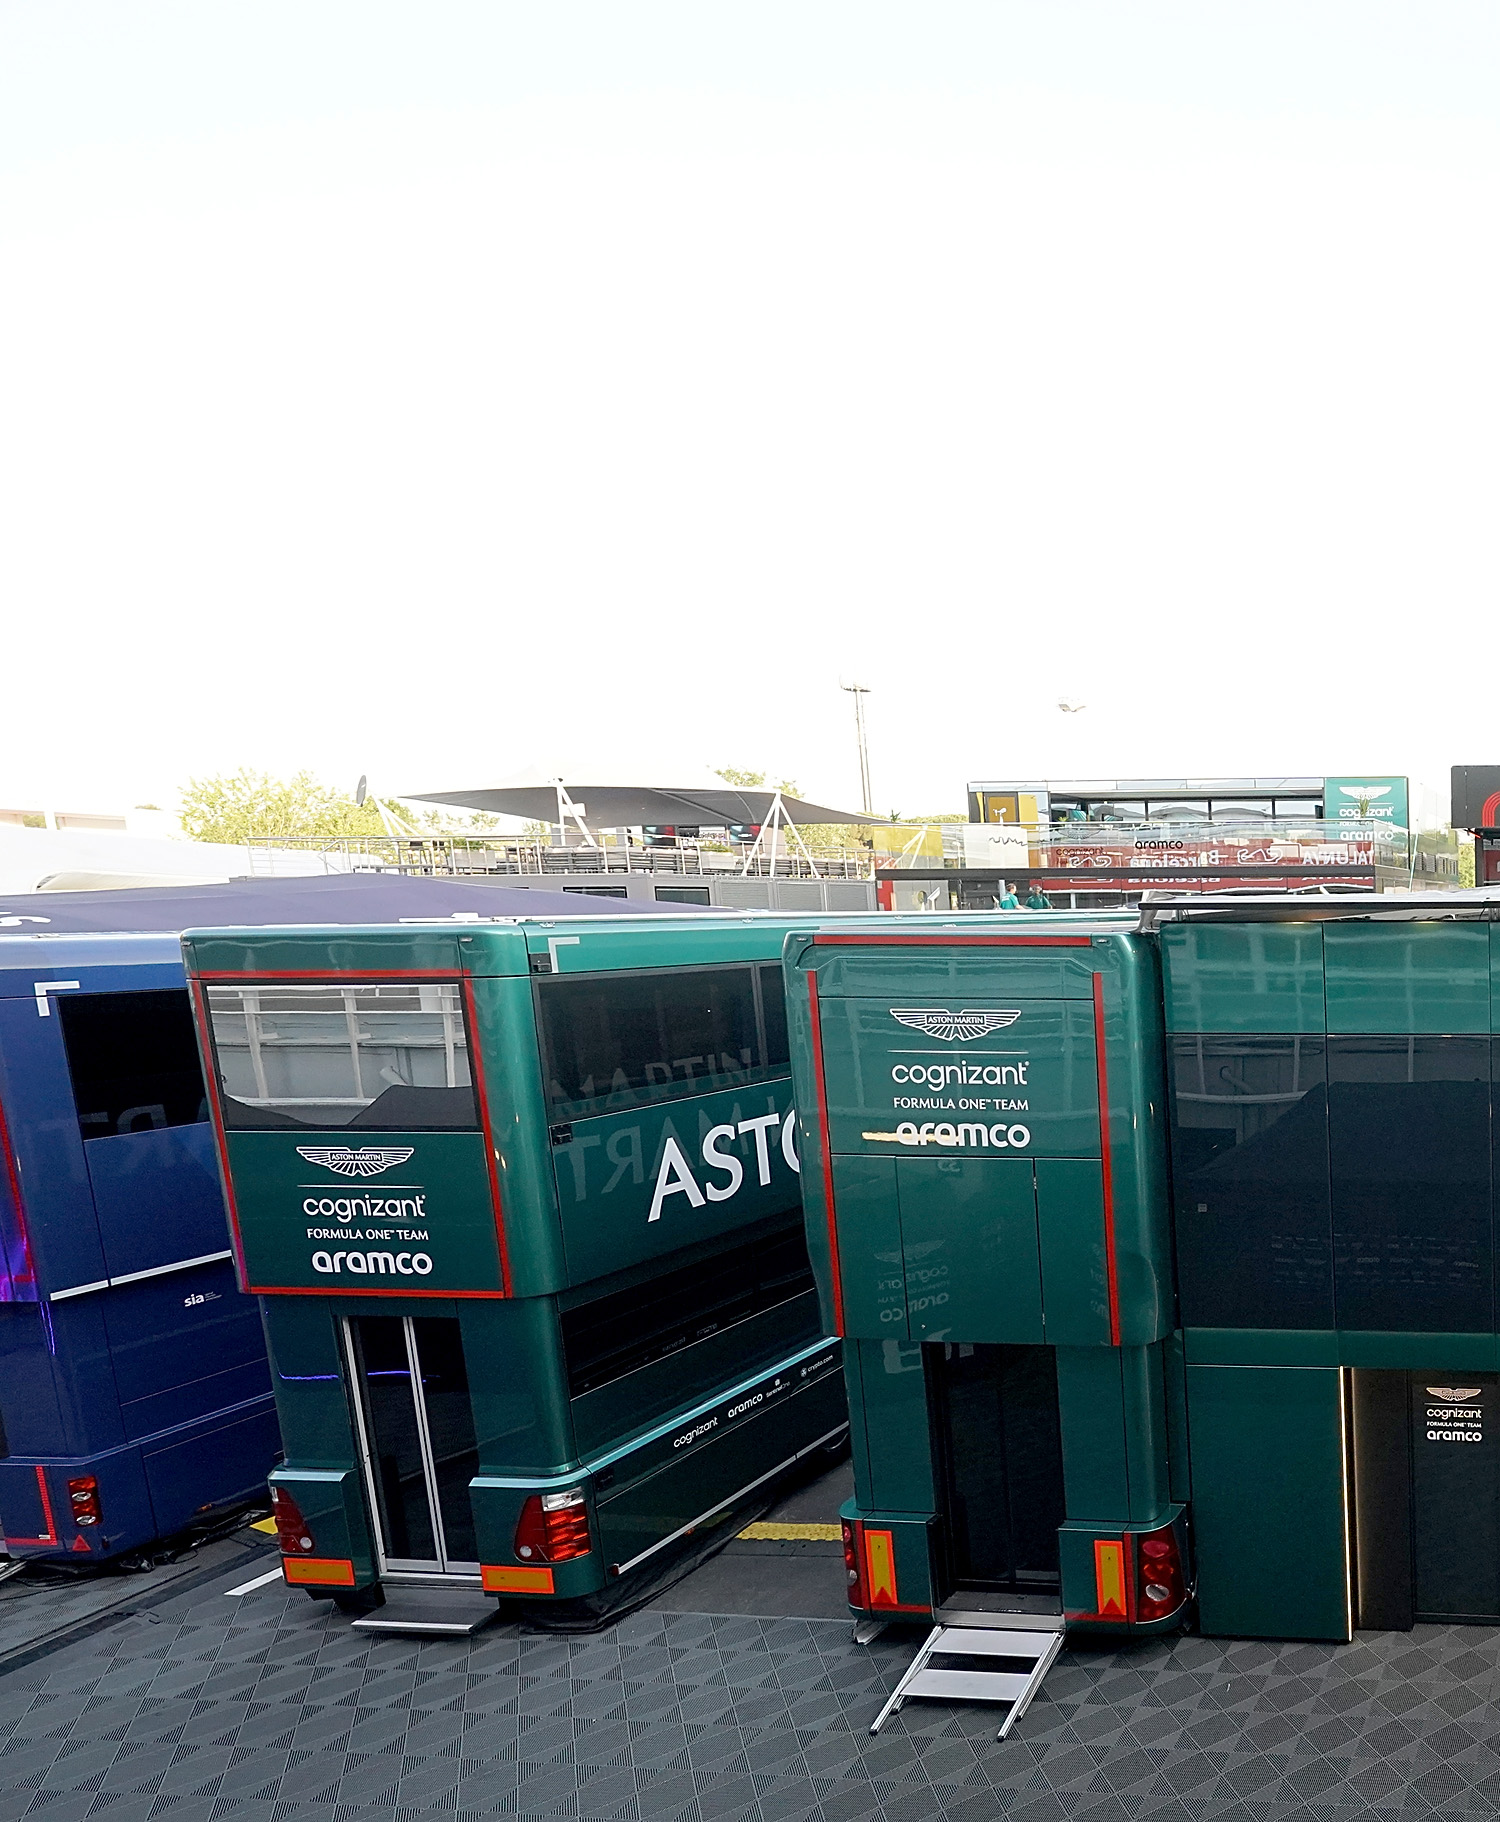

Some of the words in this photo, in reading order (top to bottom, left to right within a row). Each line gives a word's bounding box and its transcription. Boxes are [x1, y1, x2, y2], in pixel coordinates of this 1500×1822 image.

[1339, 806, 1394, 819] cogizant
[1340, 830, 1394, 841] aramco
[1134, 840, 1184, 850] aramco
[927, 1016, 953, 1024] ASTON
[954, 1016, 984, 1024] MARTIN
[893, 1097, 956, 1109] FORMULA
[993, 1099, 1029, 1110] TEAM
[896, 1122, 1031, 1148] aramco
[331, 1153, 354, 1161] ASTON
[355, 1153, 381, 1161] MARTIN
[306, 1228, 363, 1239] FORMULA
[396, 1229, 429, 1240] TEAM
[312, 1251, 433, 1275] aramco
[184, 1293, 205, 1307] sia
[807, 1354, 834, 1372] crypto.com
[727, 1393, 763, 1418] aramco
[1426, 1408, 1482, 1420] cognizant
[673, 1416, 719, 1448] cognizant
[1426, 1430, 1482, 1442] aramco
